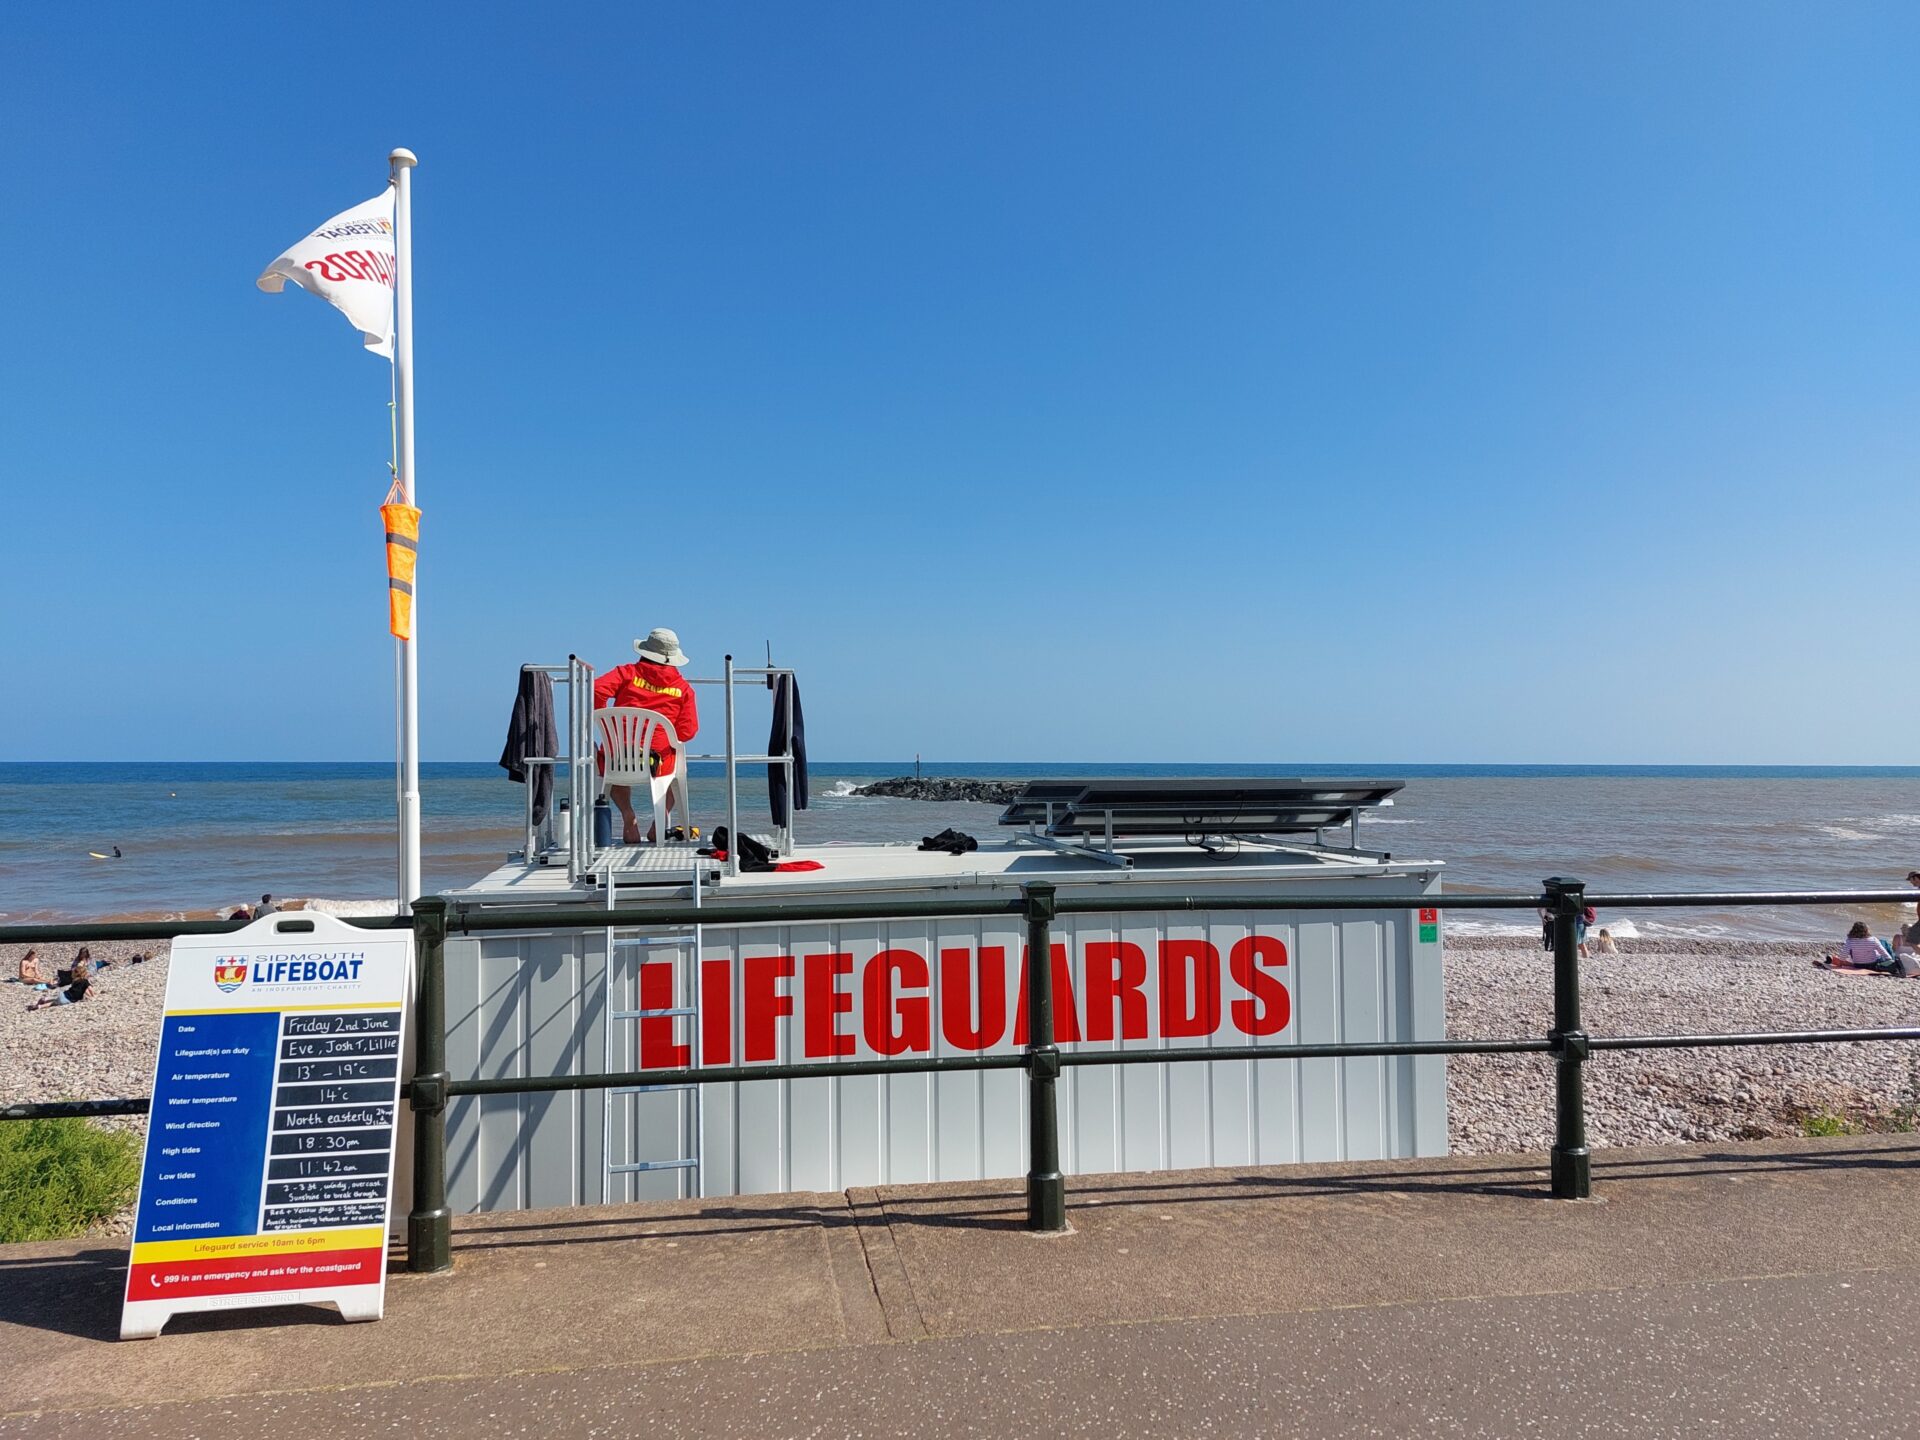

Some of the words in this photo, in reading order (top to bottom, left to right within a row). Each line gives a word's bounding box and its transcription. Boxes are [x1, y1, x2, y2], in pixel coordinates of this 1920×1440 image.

[255, 952, 364, 962] SIDMOUTH
[252, 960, 363, 983] LIFEBOAT
[640, 936, 1291, 1069] LIFEGUARDS
[289, 1018, 330, 1034] Friday
[335, 1017, 359, 1032] 2nd
[362, 1018, 389, 1029] June
[175, 1049, 220, 1057] Lifeguard(s)
[232, 1047, 250, 1055] duty
[325, 1040, 353, 1053] Josh
[369, 1039, 396, 1051] Lillie
[192, 1096, 237, 1104] temperature
[186, 1121, 220, 1129] direction
[286, 1113, 322, 1127] North
[327, 1111, 373, 1125] easterly
[155, 1198, 198, 1206] Conditions
[175, 1222, 220, 1230] information
[194, 1243, 236, 1253] Lifeguard
[237, 1241, 269, 1249] service
[271, 1239, 294, 1247] 10am
[307, 1237, 326, 1246] 6pm
[163, 1275, 180, 1283] 999
[181, 1274, 190, 1282] in
[203, 1270, 250, 1280] emergency
[251, 1269, 269, 1277] and
[269, 1267, 284, 1276] ask
[286, 1266, 298, 1274] for
[299, 1265, 314, 1273] the
[314, 1261, 362, 1272] coastguard
